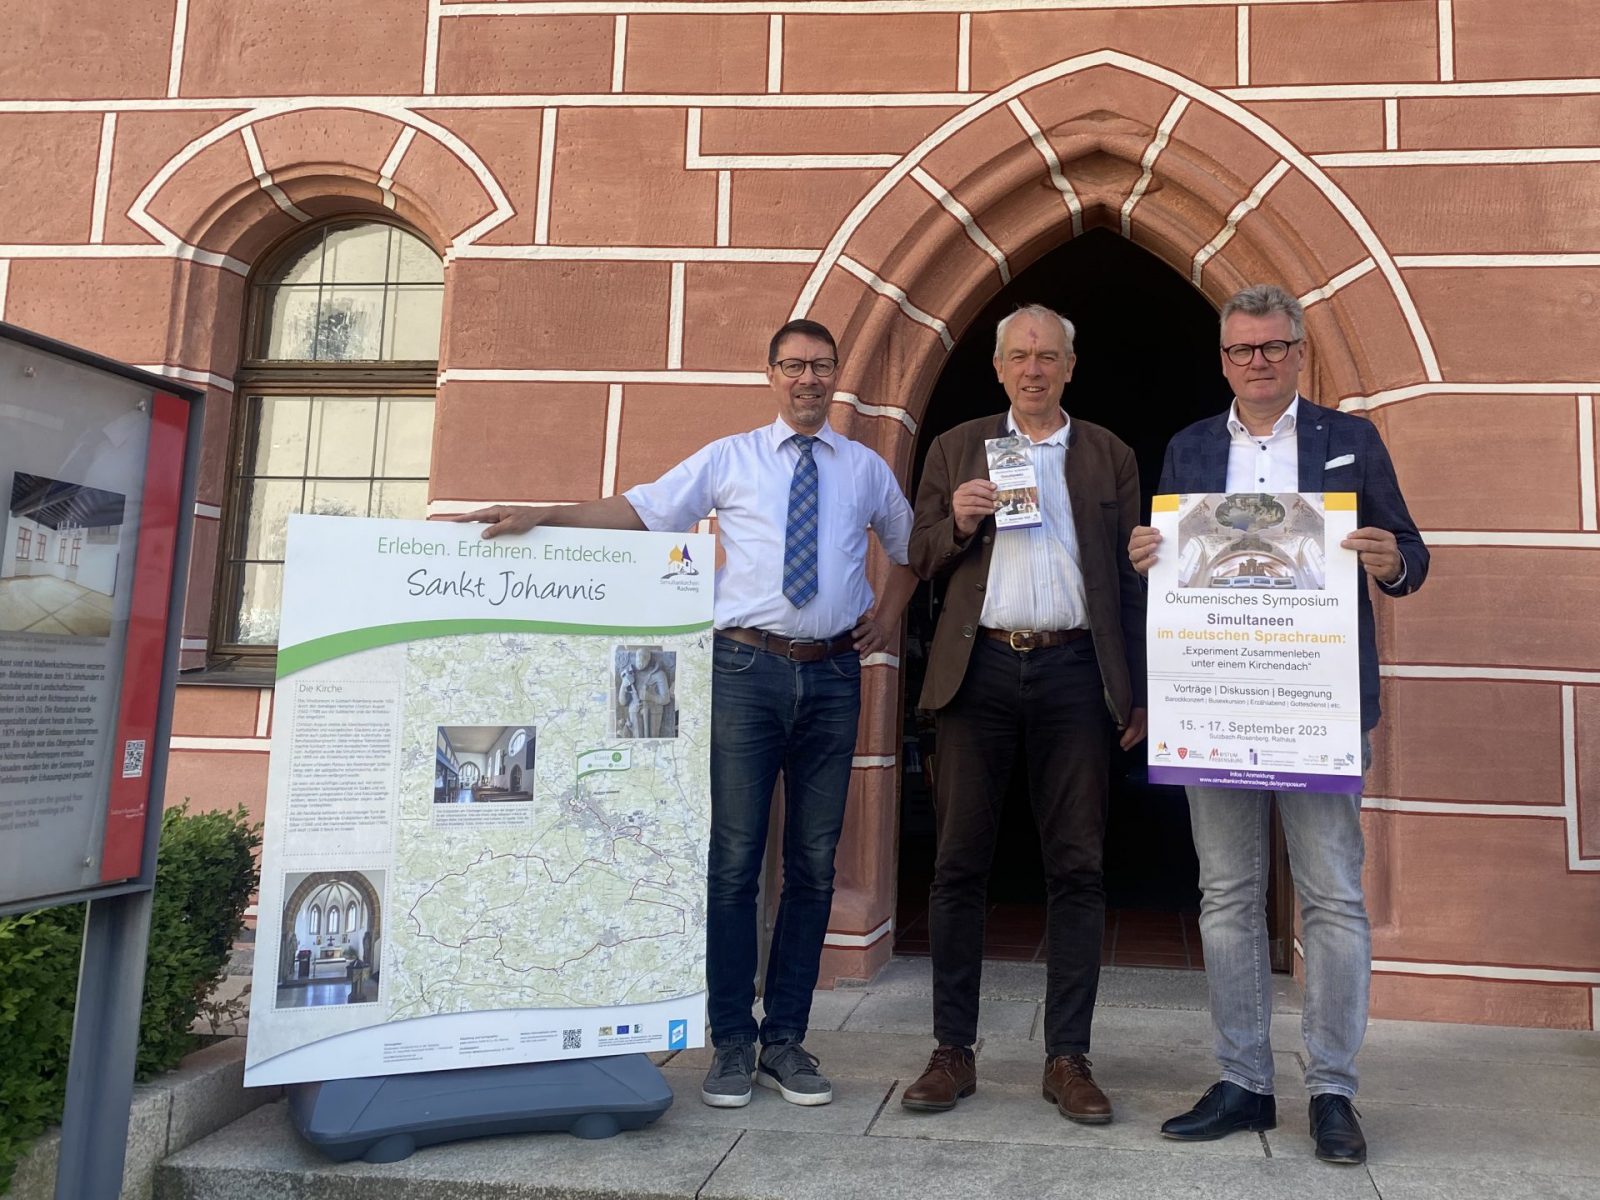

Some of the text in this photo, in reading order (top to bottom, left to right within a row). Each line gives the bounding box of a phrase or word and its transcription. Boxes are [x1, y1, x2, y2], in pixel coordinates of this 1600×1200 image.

[377, 537, 637, 564] Erleben. Erfahren. Entdecken.
[407, 569, 606, 606] Sankt Johannis
[1165, 590, 1338, 608] Ökumenisches Symposium
[1207, 613, 1294, 626] Simultaneen
[1157, 628, 1346, 644] im deutschen Sprachraum:
[1241, 648, 1320, 658] Zusammenleben
[1191, 660, 1214, 668] unter
[1218, 661, 1246, 669] einem
[299, 684, 343, 693] Die Kirche
[1173, 684, 1332, 700] Vorträge Diskussion Begegnung
[1180, 720, 1196, 731] 15.
[1208, 721, 1225, 732] 17.
[1228, 722, 1294, 736] September
[1298, 725, 1327, 736] 2023
